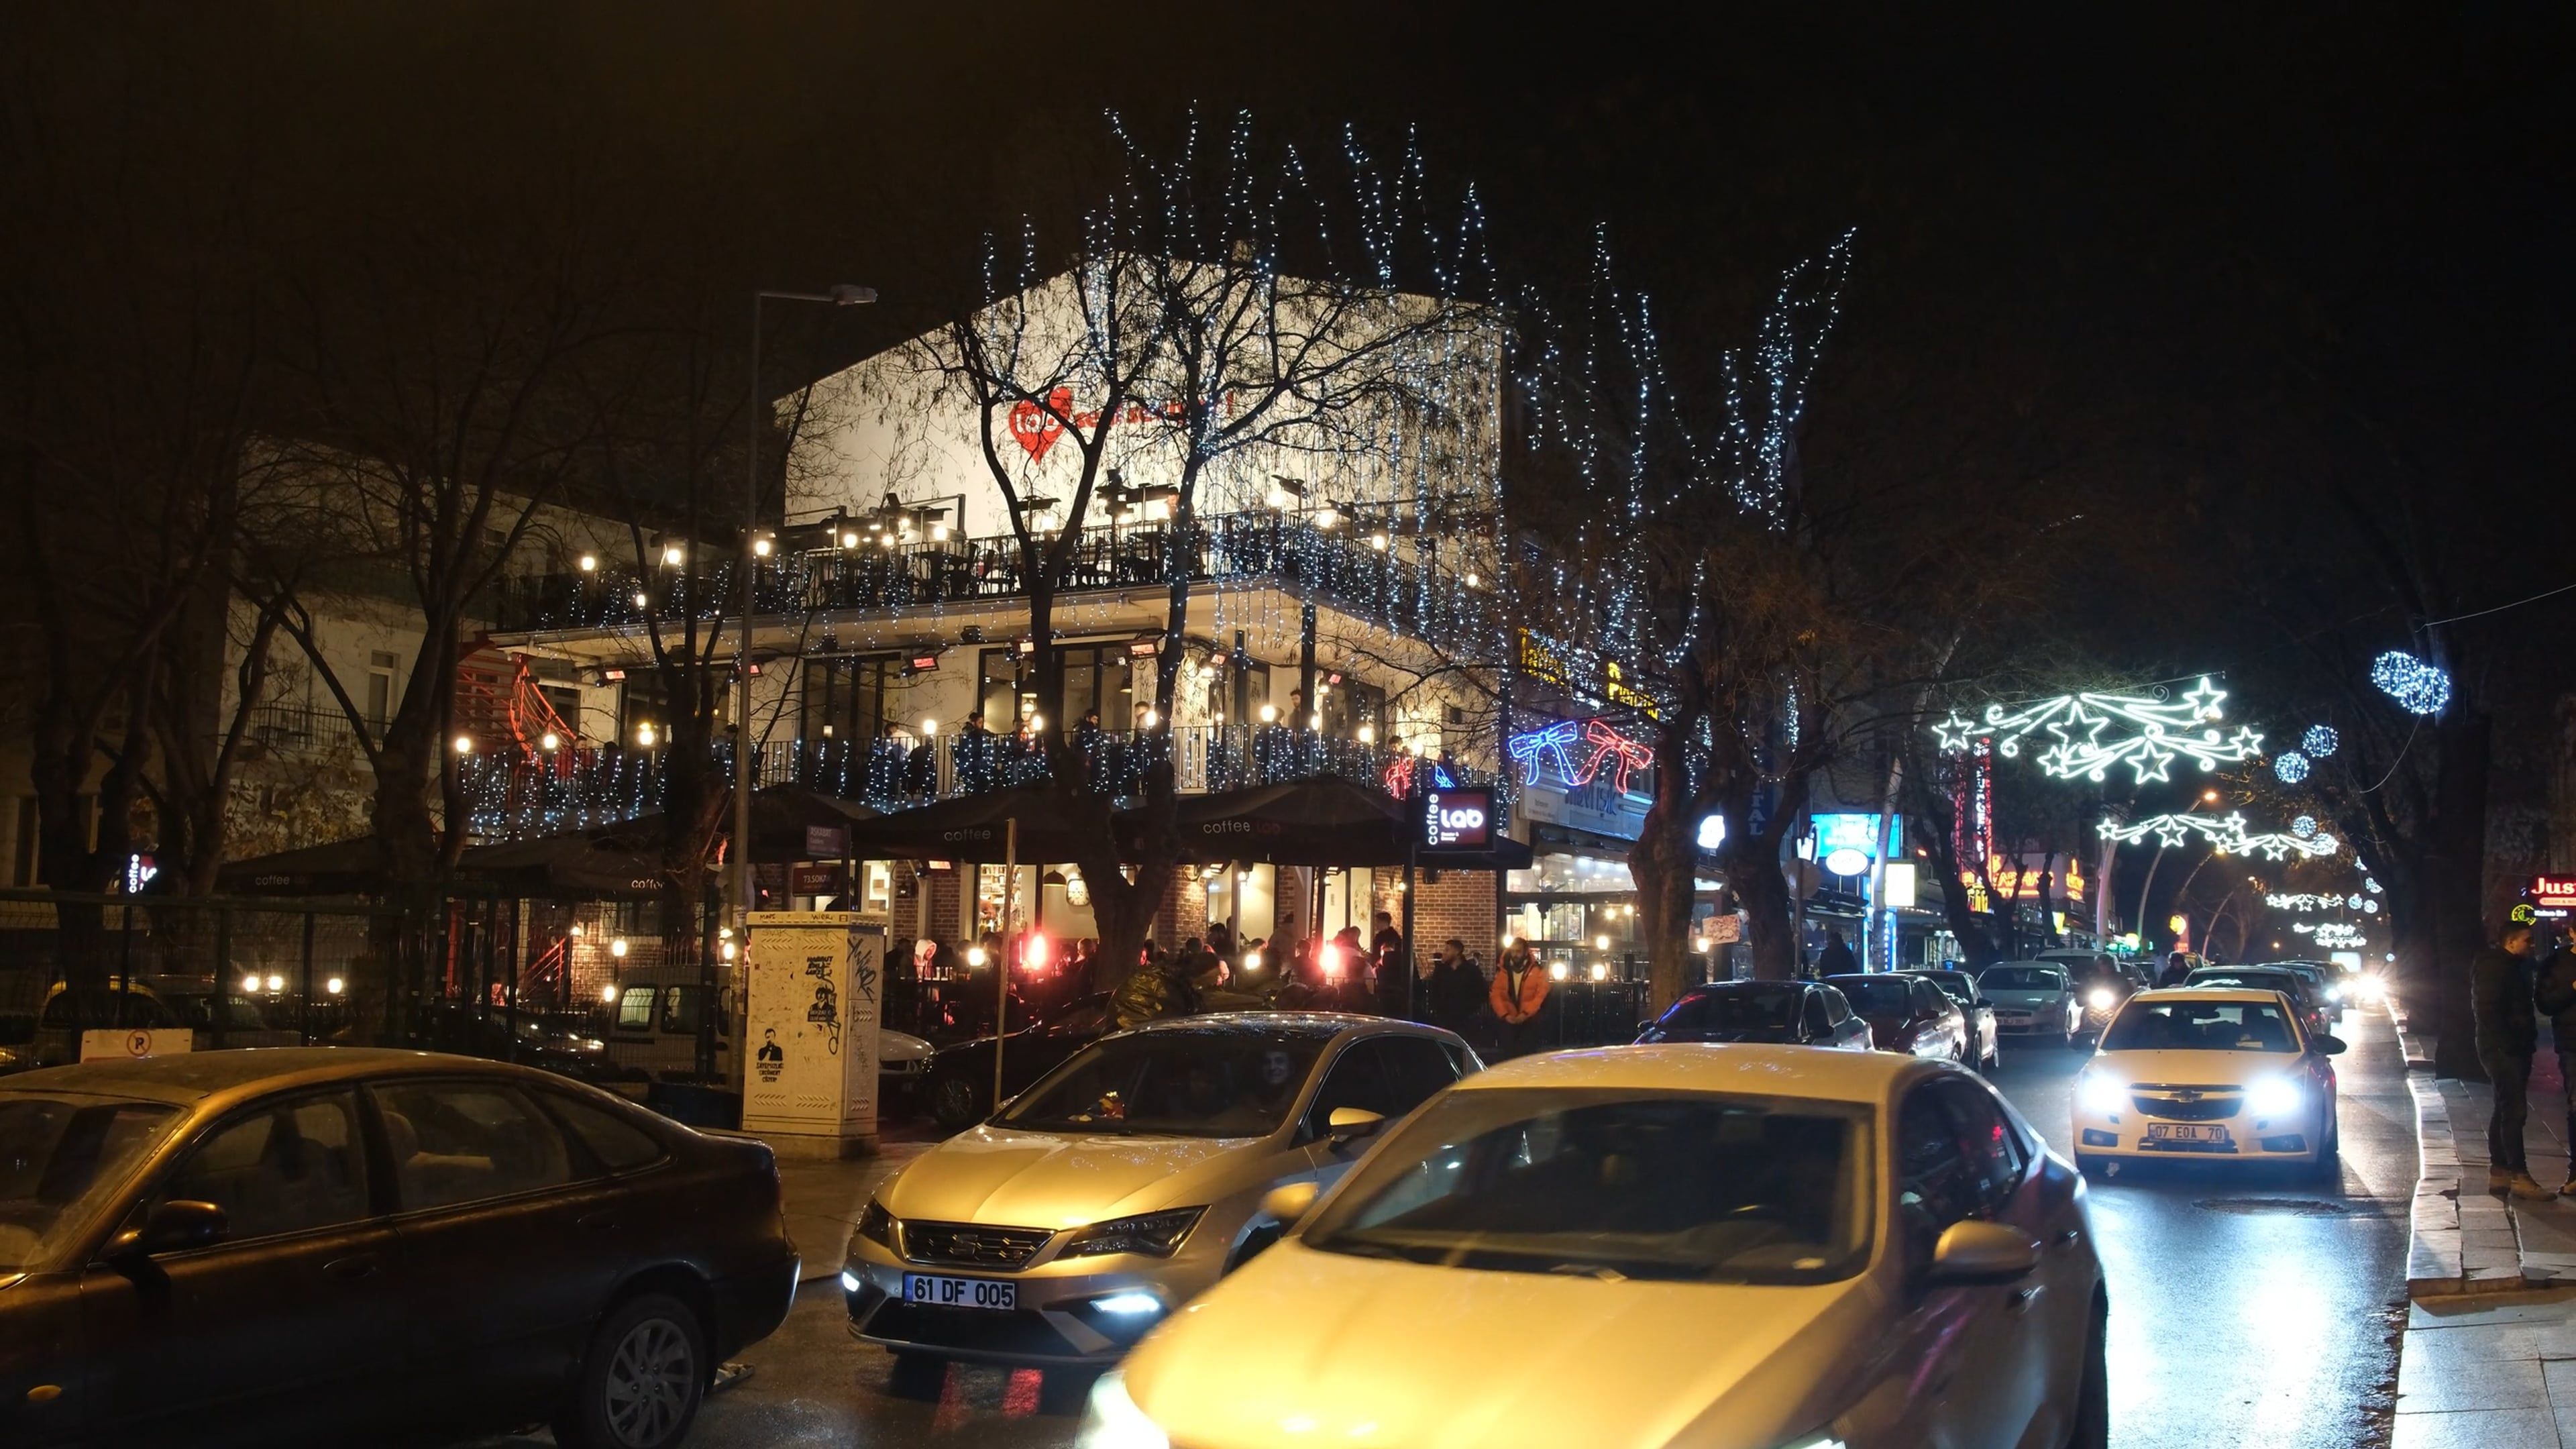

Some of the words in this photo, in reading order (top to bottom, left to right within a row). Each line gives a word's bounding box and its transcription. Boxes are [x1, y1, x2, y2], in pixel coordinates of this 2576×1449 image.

[1203, 820, 1250, 834] coffee
[1426, 794, 1439, 845] coffee
[944, 828, 991, 842] coffee
[129, 853, 140, 894] coffee
[255, 875, 290, 886] coffee
[2530, 877, 2576, 894] Jus
[2155, 1126, 2169, 1138] 07
[2208, 1128, 2222, 1139] 70
[914, 1277, 933, 1301] 61
[942, 1279, 967, 1302] DF
[975, 1283, 1014, 1307] 005
